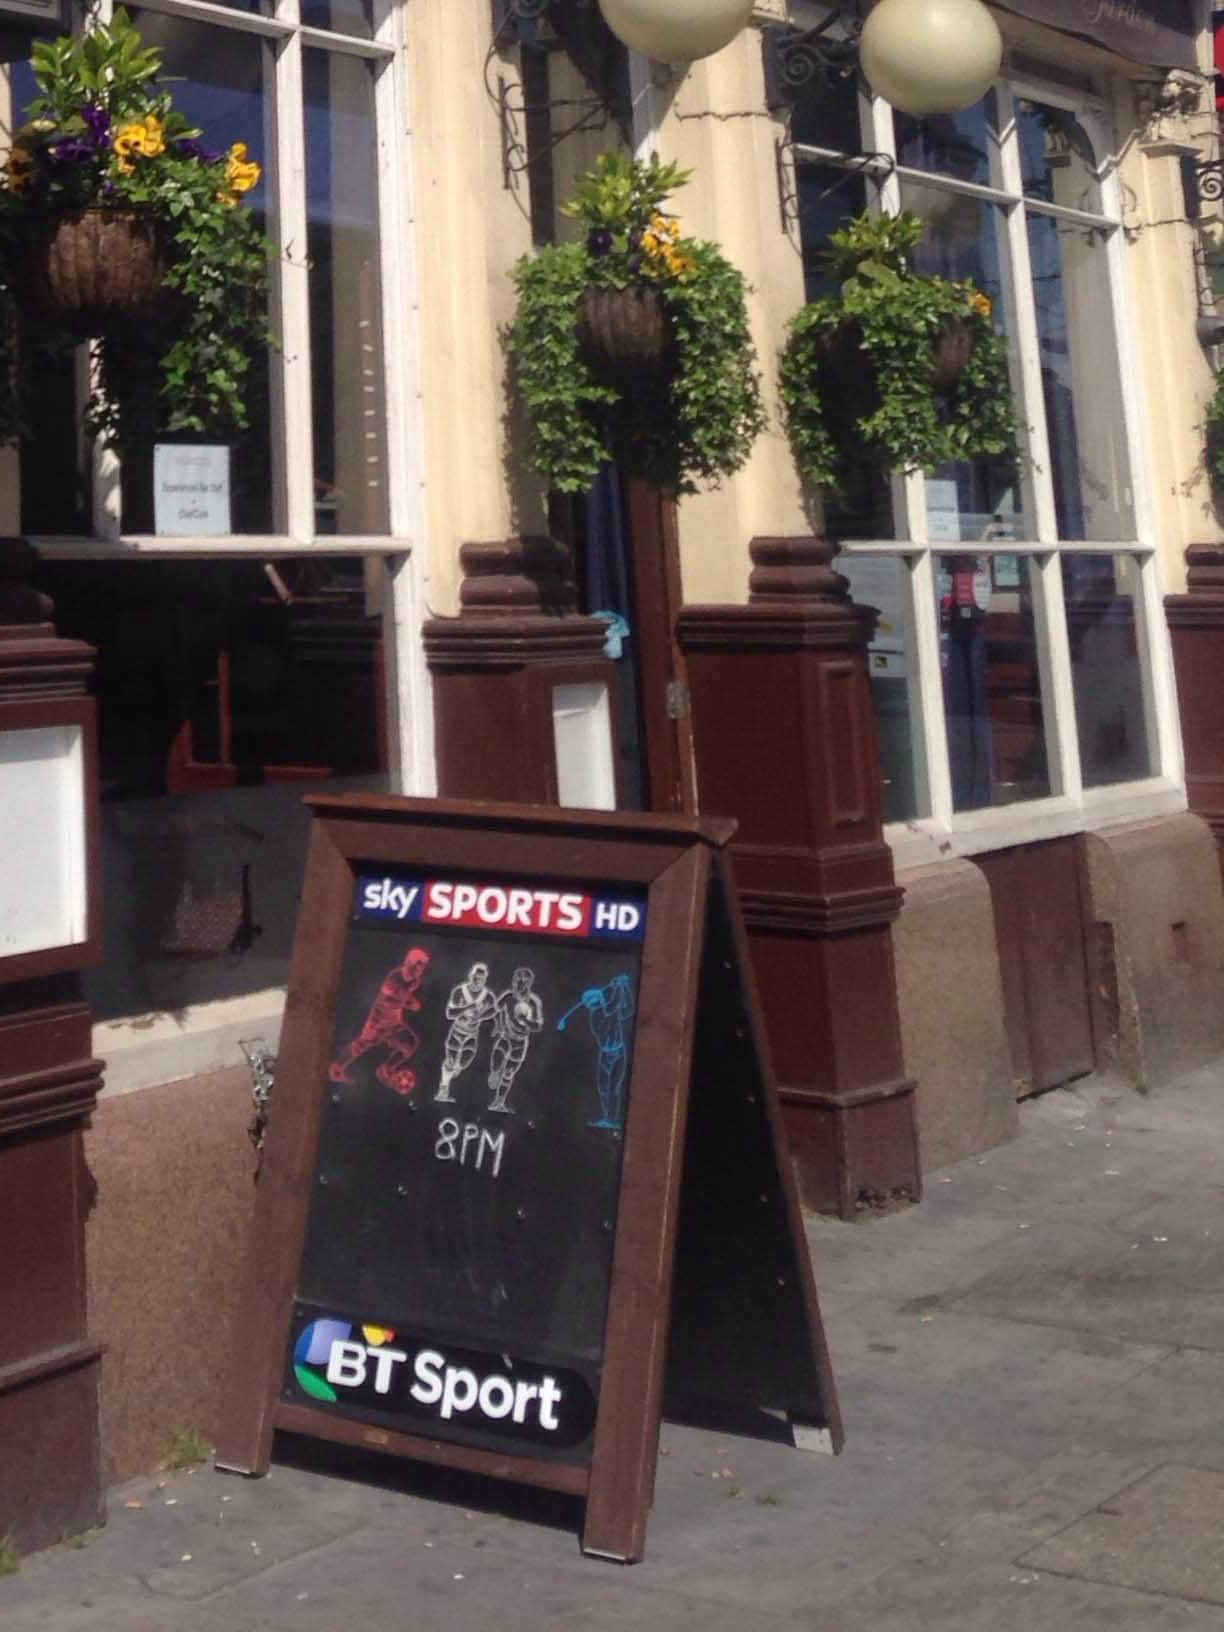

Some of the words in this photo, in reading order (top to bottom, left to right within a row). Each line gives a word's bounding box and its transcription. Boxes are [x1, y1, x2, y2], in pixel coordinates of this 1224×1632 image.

[363, 877, 419, 919] sky
[427, 882, 584, 931] SPORTS
[594, 902, 640, 932] HD
[434, 1116, 505, 1178] 8PM
[326, 1338, 408, 1395] BT
[409, 1348, 562, 1431] Sport
